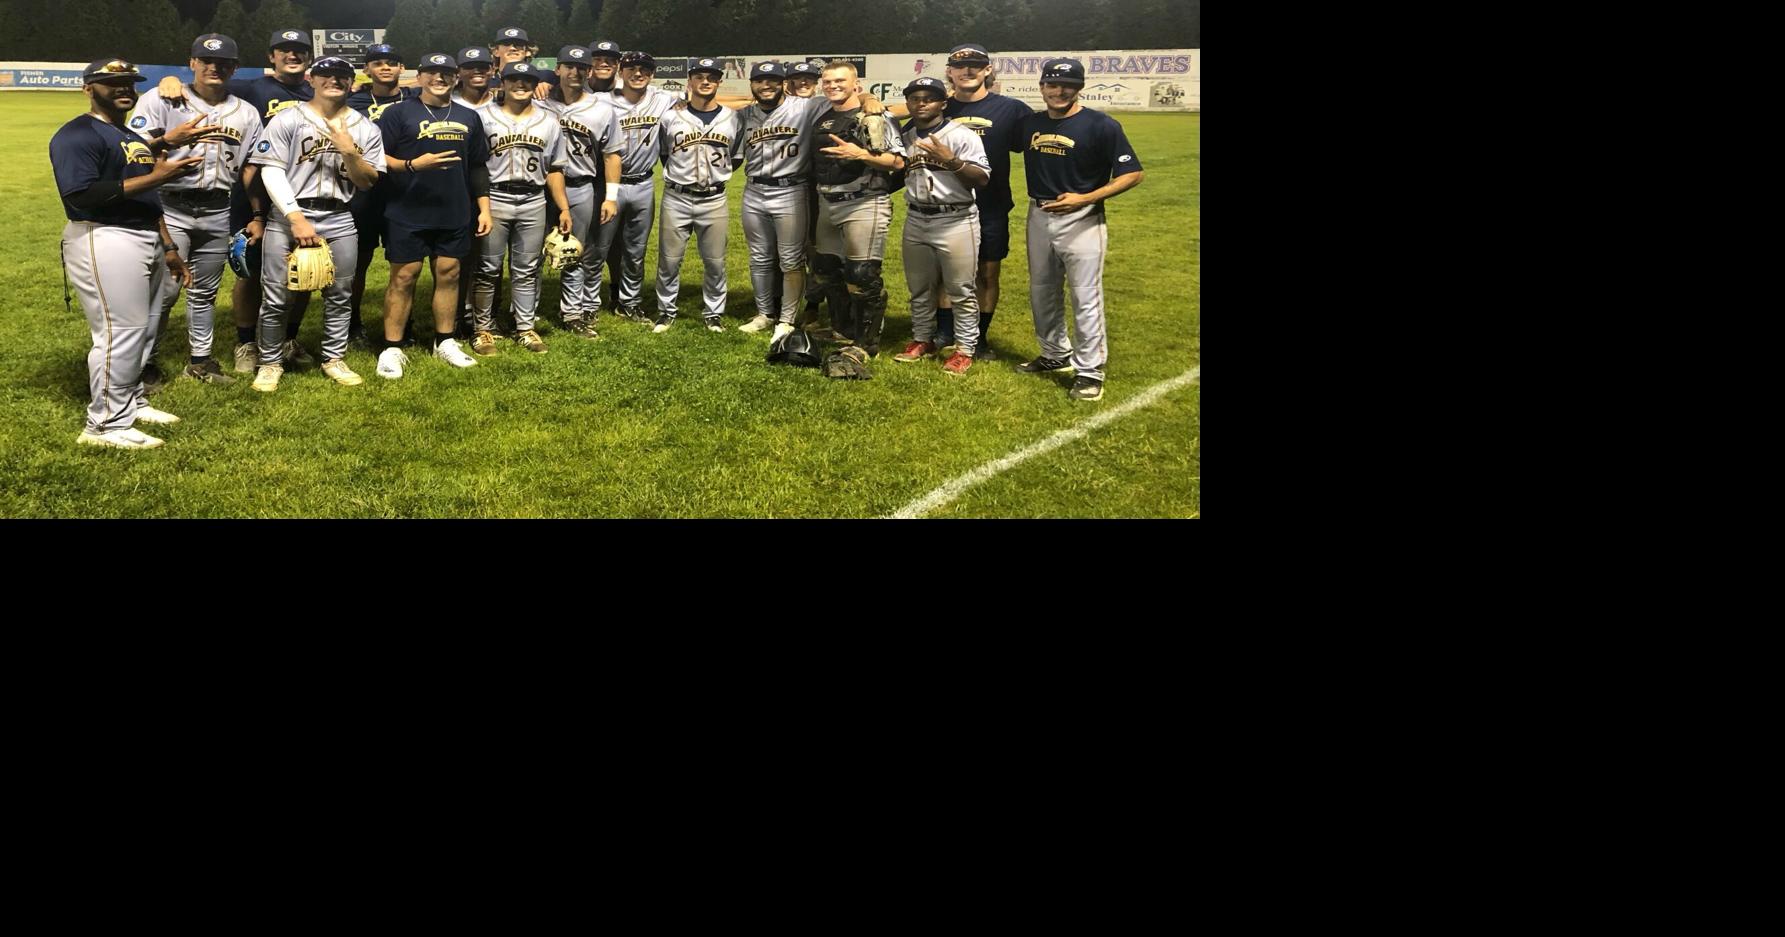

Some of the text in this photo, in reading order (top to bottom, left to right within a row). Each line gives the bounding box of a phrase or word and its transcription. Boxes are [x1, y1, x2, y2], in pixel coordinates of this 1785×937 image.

[330, 32, 365, 43] City
[1088, 55, 1192, 74] BRAVES
[20, 76, 85, 85] Auto Parts
[779, 143, 799, 158] 10
[526, 156, 540, 173] 6
